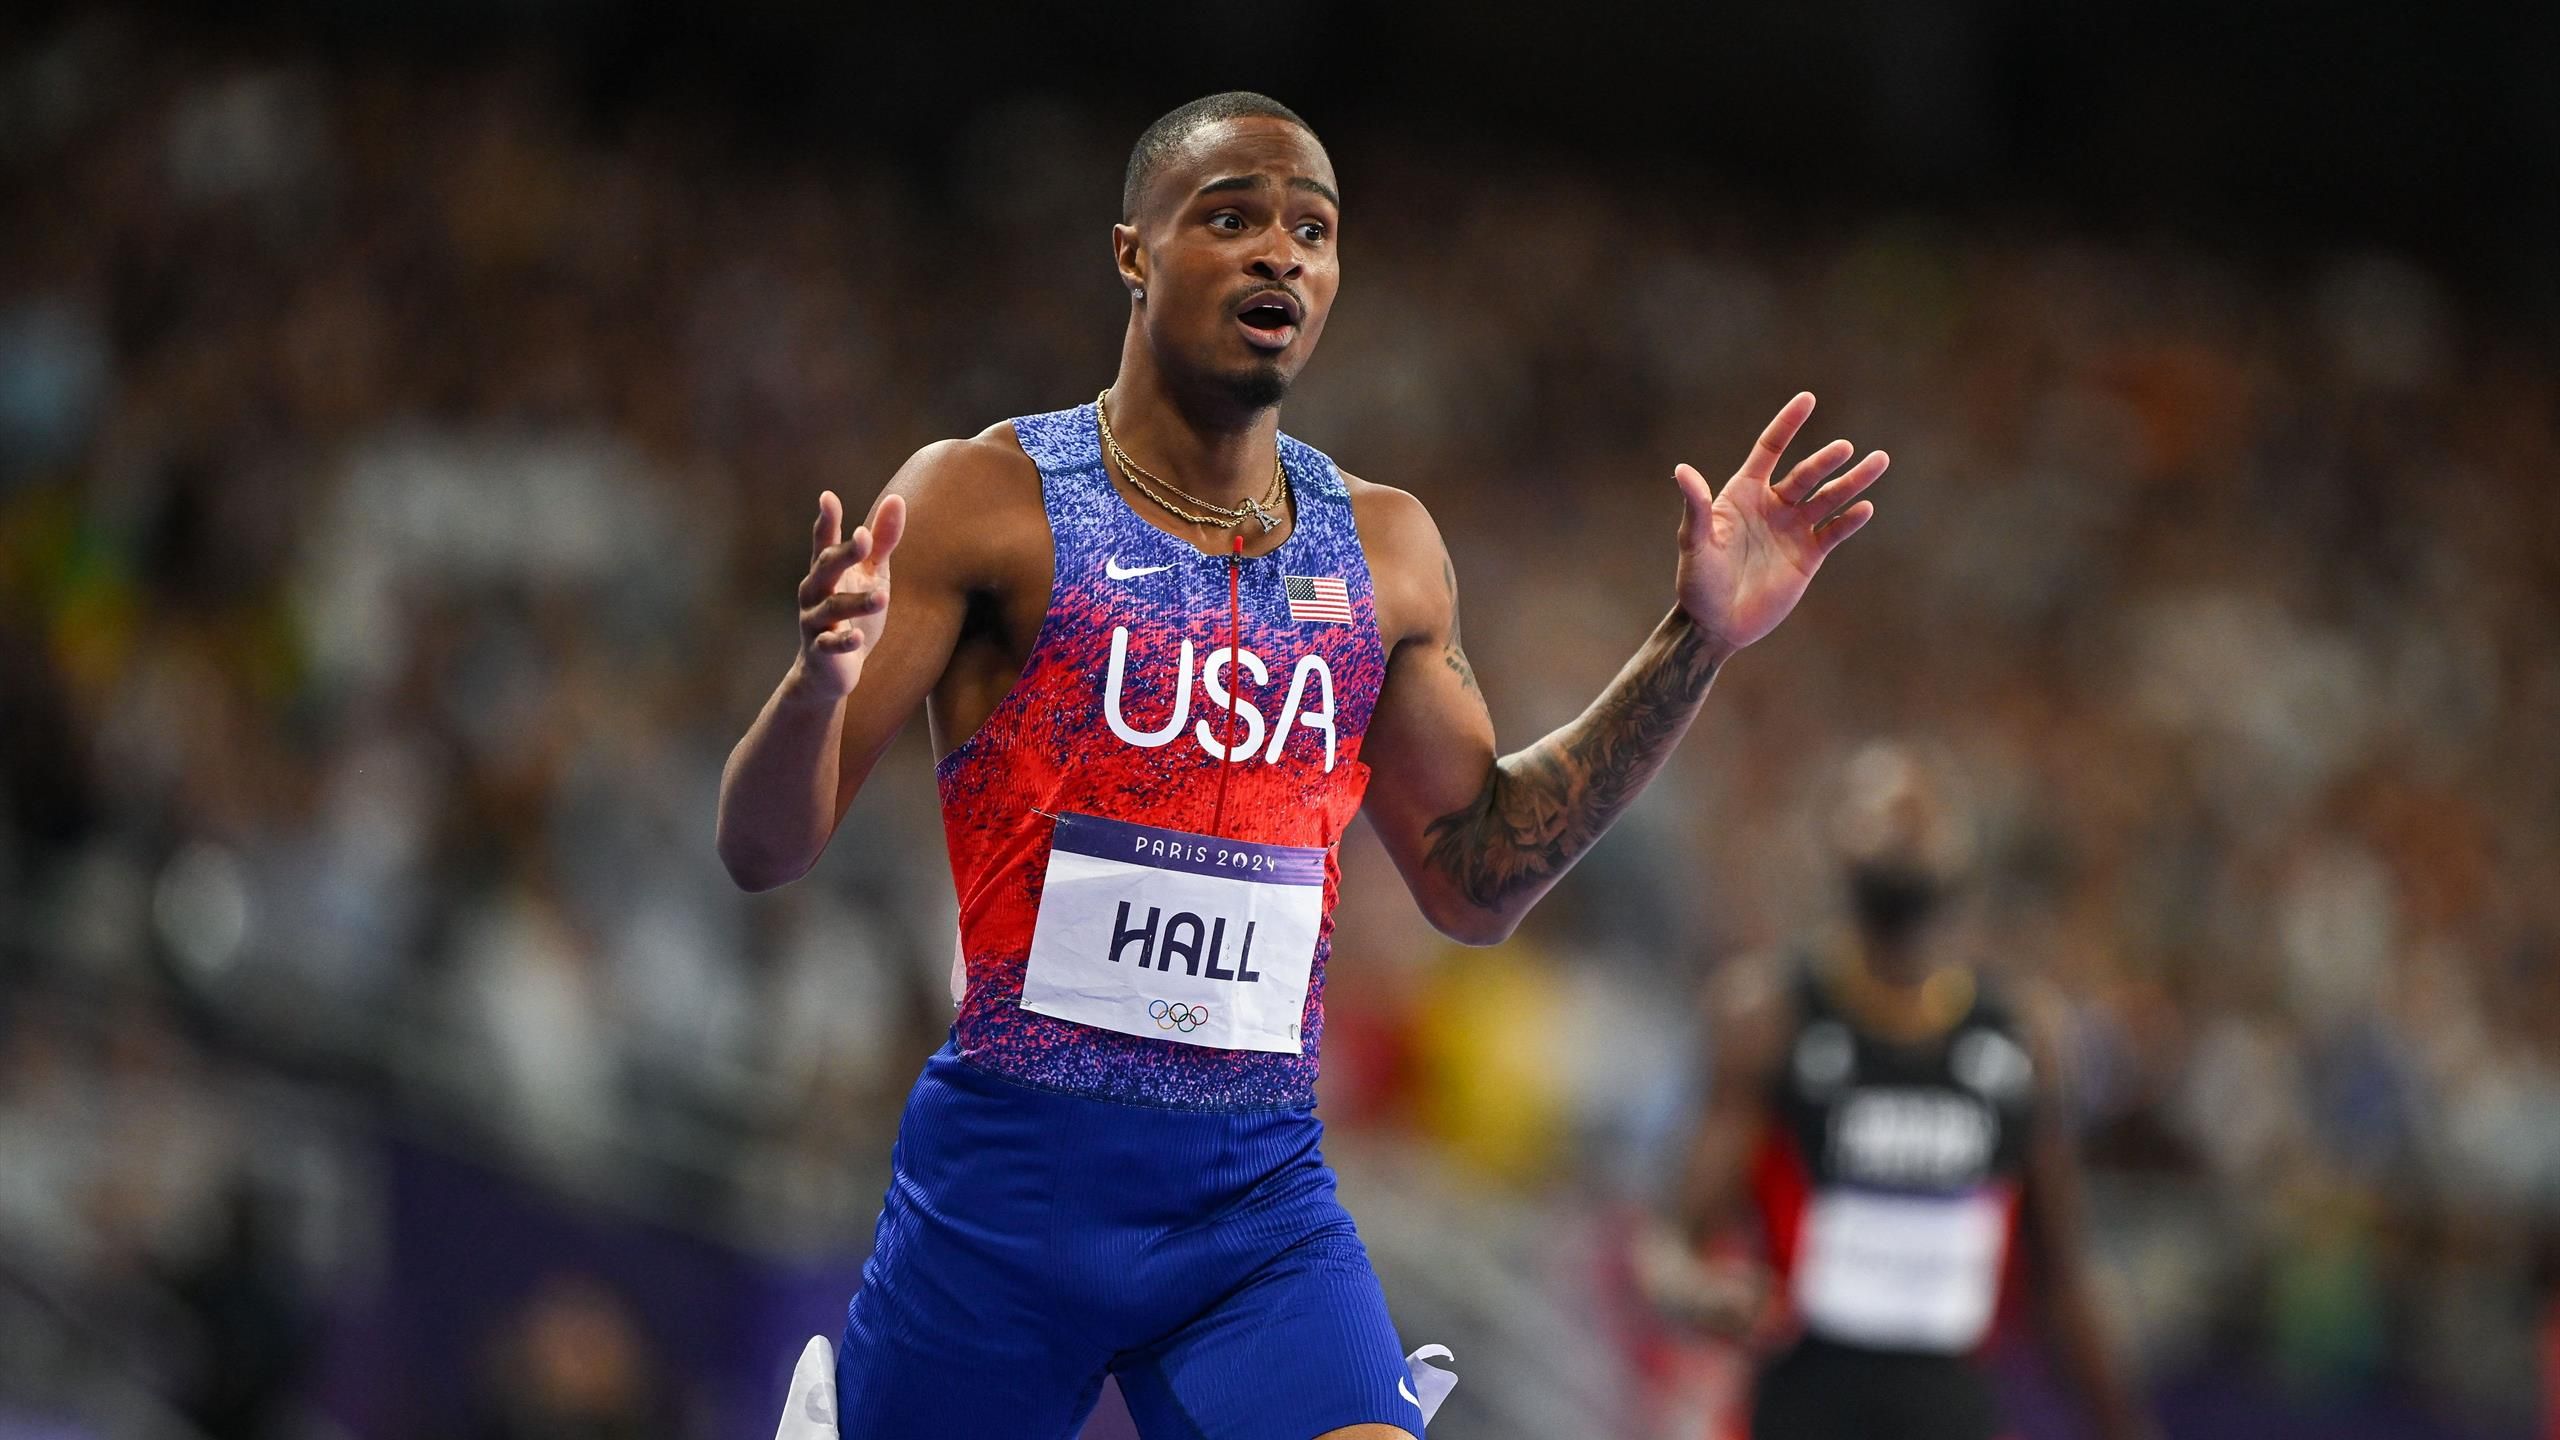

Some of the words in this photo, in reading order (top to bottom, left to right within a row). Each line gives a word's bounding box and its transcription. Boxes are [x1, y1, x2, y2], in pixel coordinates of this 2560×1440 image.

[1104, 626, 1336, 773] USA
[1216, 850, 1275, 873] 2024
[1108, 901, 1260, 983] HALL
